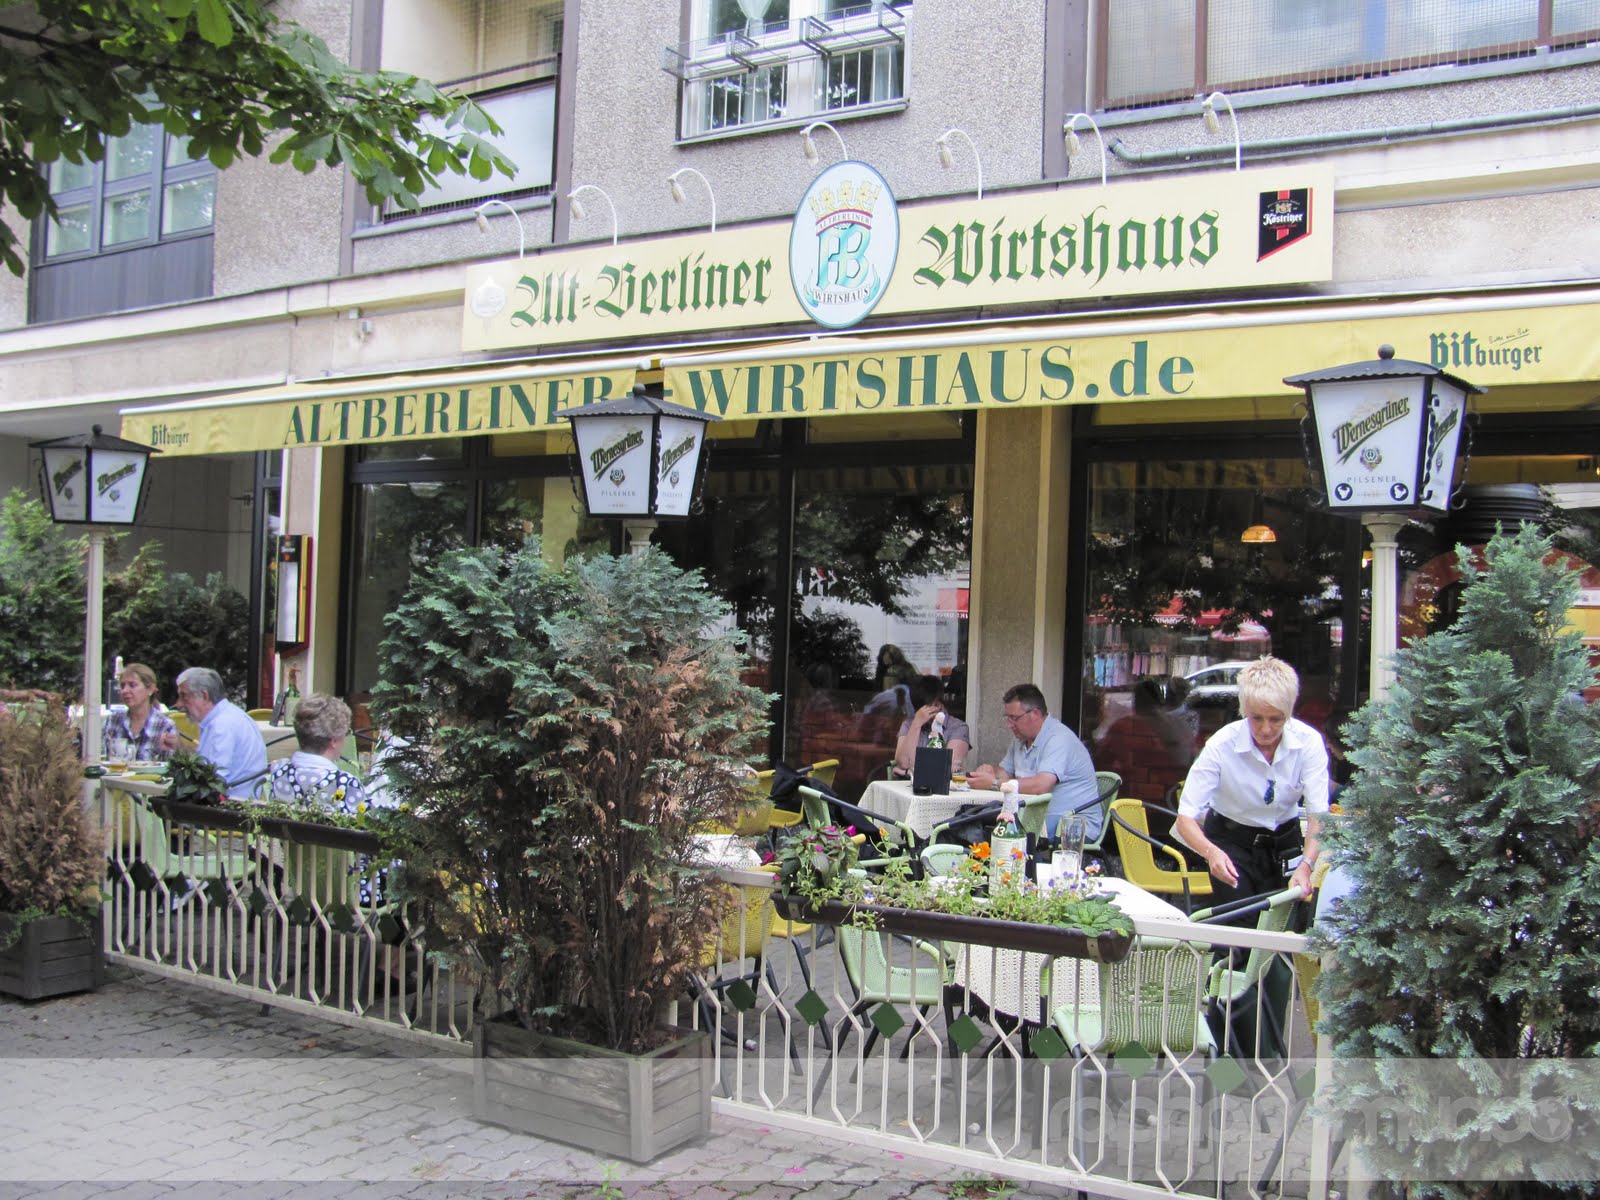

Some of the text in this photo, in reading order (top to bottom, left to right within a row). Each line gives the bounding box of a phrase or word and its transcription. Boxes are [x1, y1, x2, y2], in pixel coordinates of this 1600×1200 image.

[913, 205, 1220, 289] Wirtshaus
[814, 287, 869, 304] WIRTSHAUS
[1429, 331, 1543, 371] Bitburger
[1347, 475, 1397, 483] PILSENER
